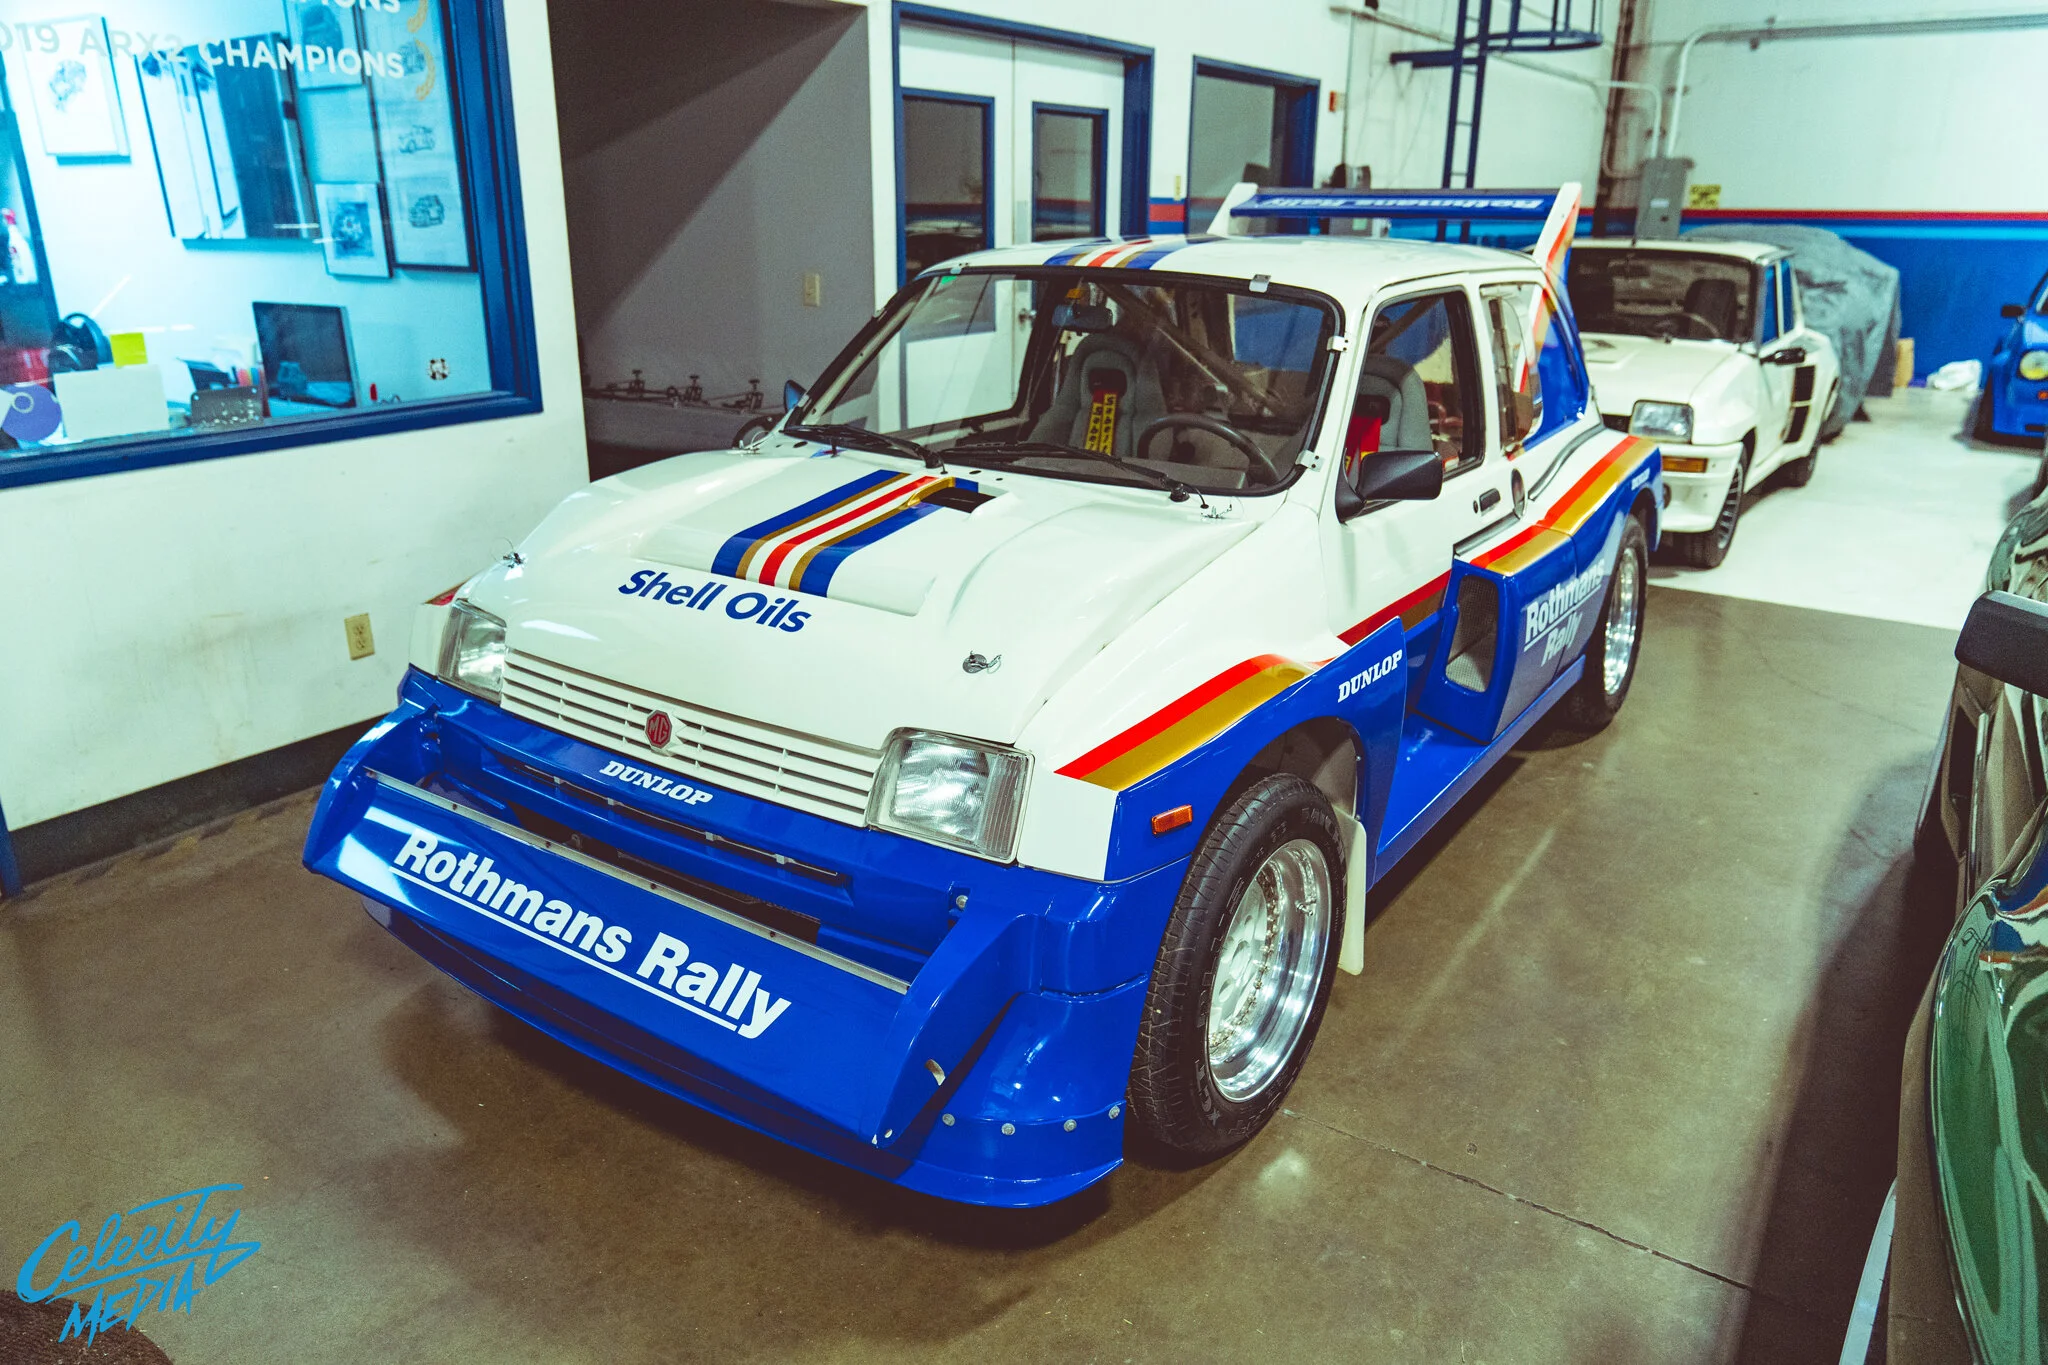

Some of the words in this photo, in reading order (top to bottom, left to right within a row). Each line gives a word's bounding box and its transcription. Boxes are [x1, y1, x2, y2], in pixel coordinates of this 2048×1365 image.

[79, 28, 188, 63] ARX2
[199, 37, 405, 79] CHAMPIONS
[618, 569, 728, 611] Shell
[725, 592, 812, 633] Oils
[1525, 558, 1605, 644] Rothmans
[1541, 610, 1583, 667] Rally
[1337, 648, 1403, 703] DUNLOP
[649, 715, 669, 743] MG
[599, 760, 713, 806] DUNLOP
[393, 828, 633, 963] Rothmans
[636, 931, 792, 1039] Rally
